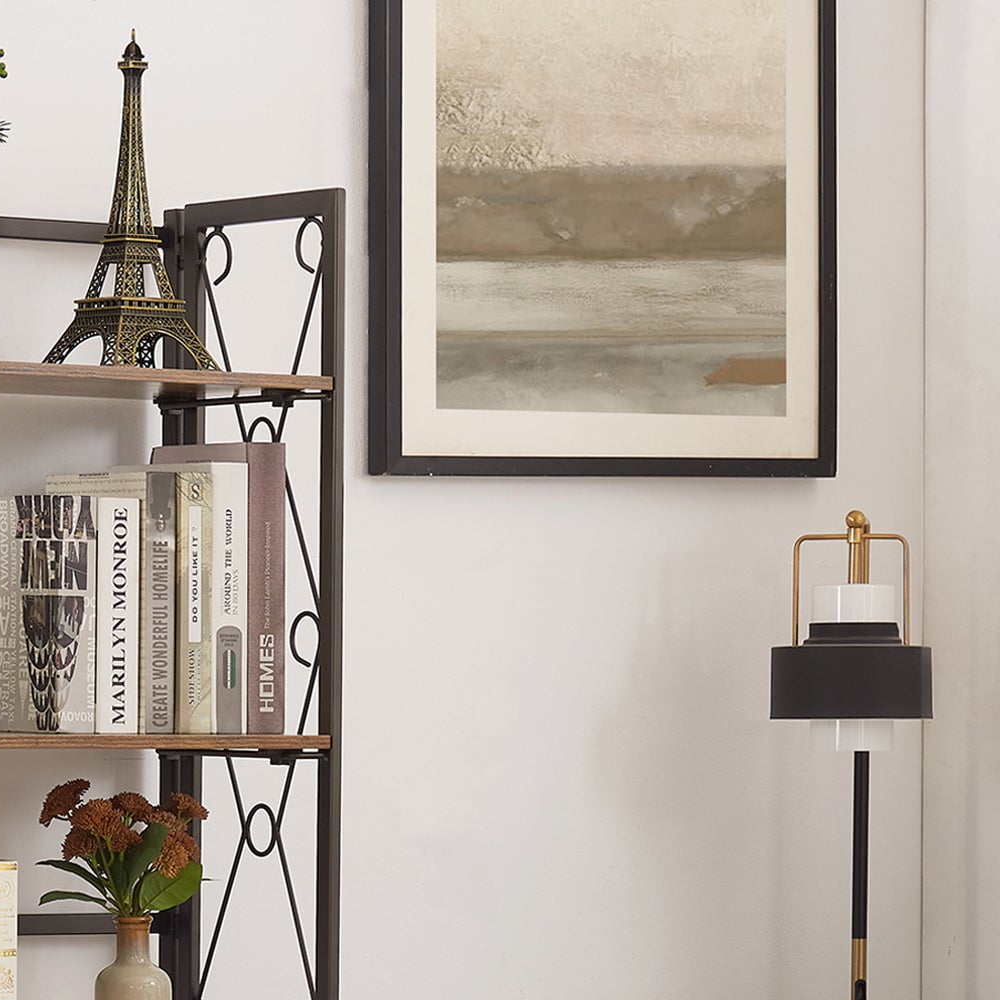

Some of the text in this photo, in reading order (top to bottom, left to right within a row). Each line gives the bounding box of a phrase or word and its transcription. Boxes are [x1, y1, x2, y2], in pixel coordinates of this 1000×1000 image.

[0, 500, 9, 592] BROADWAY
[9, 540, 17, 586] CENTRAL
[192, 536, 198, 548] IT
[224, 509, 233, 615] AROUND THE WORLD
[111, 507, 128, 725] MARILYN MONROE
[153, 539, 168, 728] CREATE WONDERFUL HOMELIFE
[192, 606, 198, 623] DO
[187, 648, 196, 706] SIDESHOW
[260, 634, 275, 713] HOMES
